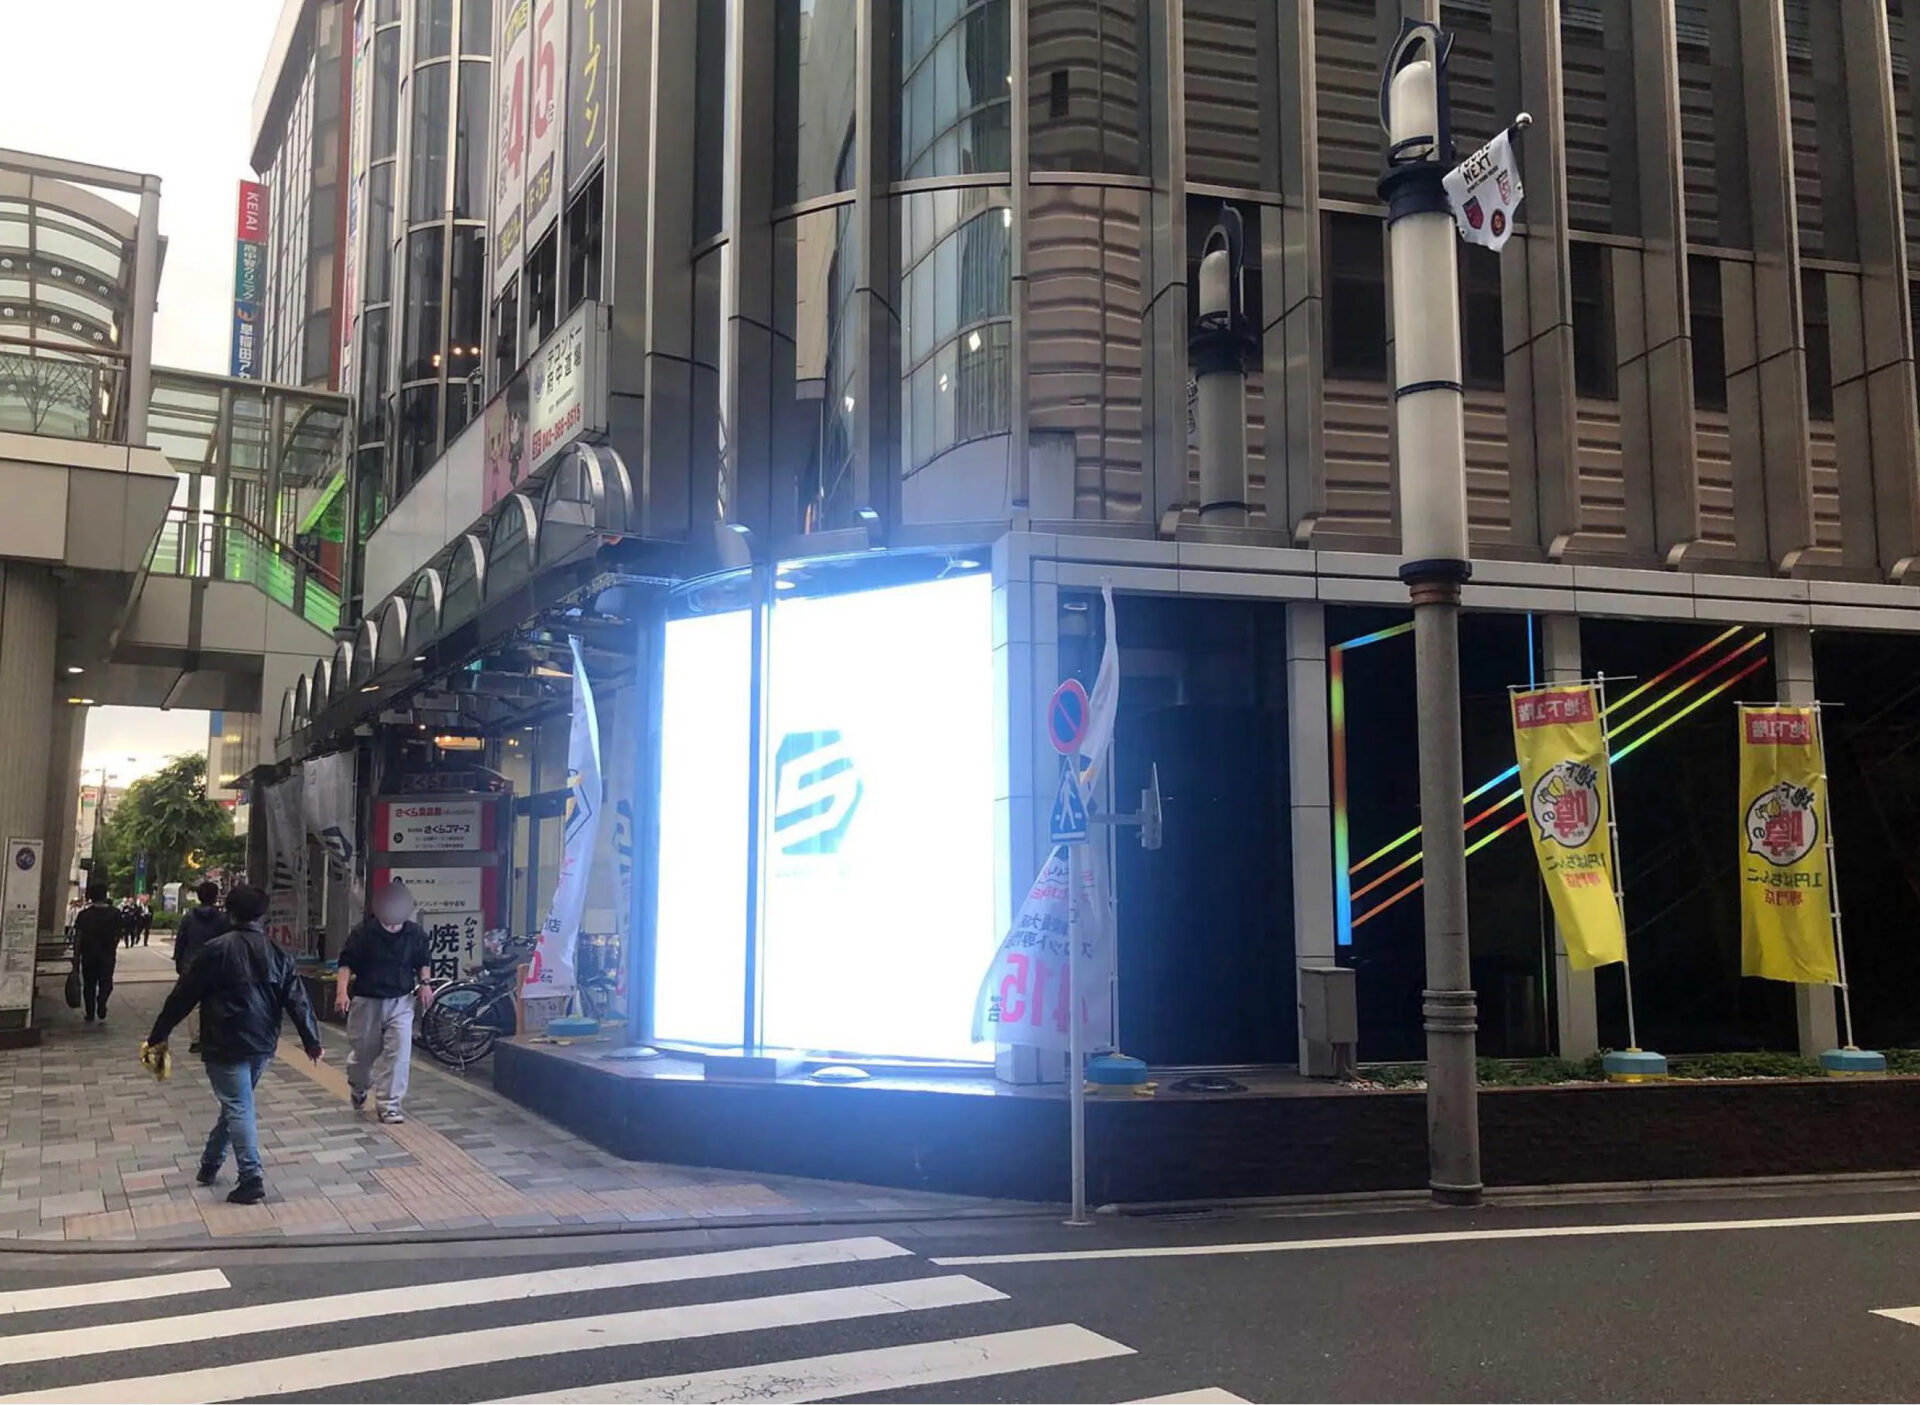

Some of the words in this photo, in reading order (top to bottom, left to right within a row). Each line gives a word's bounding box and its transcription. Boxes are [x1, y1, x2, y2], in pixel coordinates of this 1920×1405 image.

[1463, 152, 1492, 185] NEXT
[245, 191, 259, 231] KEIAI
[429, 923, 460, 981] 焼肉
